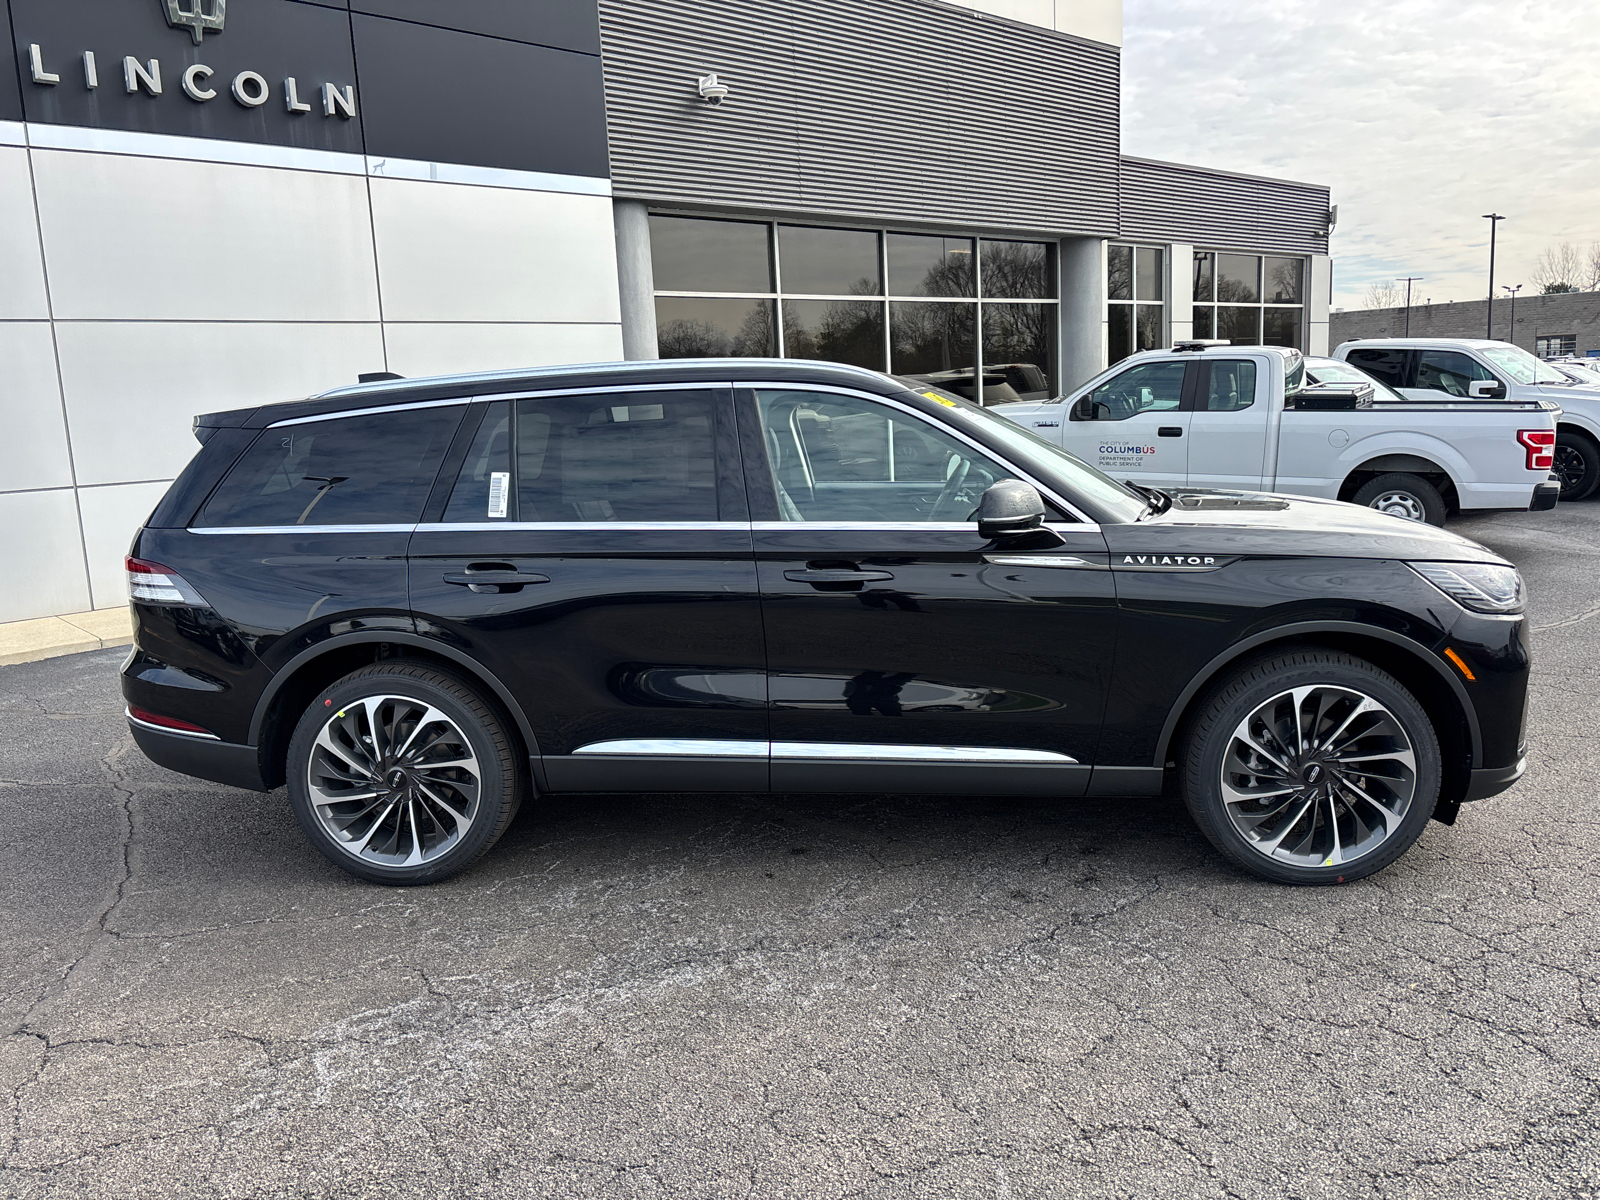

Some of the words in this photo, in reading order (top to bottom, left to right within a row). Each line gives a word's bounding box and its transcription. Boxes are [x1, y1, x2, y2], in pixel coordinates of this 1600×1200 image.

[28, 43, 356, 119] LINCOLN
[1099, 445, 1156, 454] COLUMBUS
[1123, 555, 1215, 565] AVIATOR
